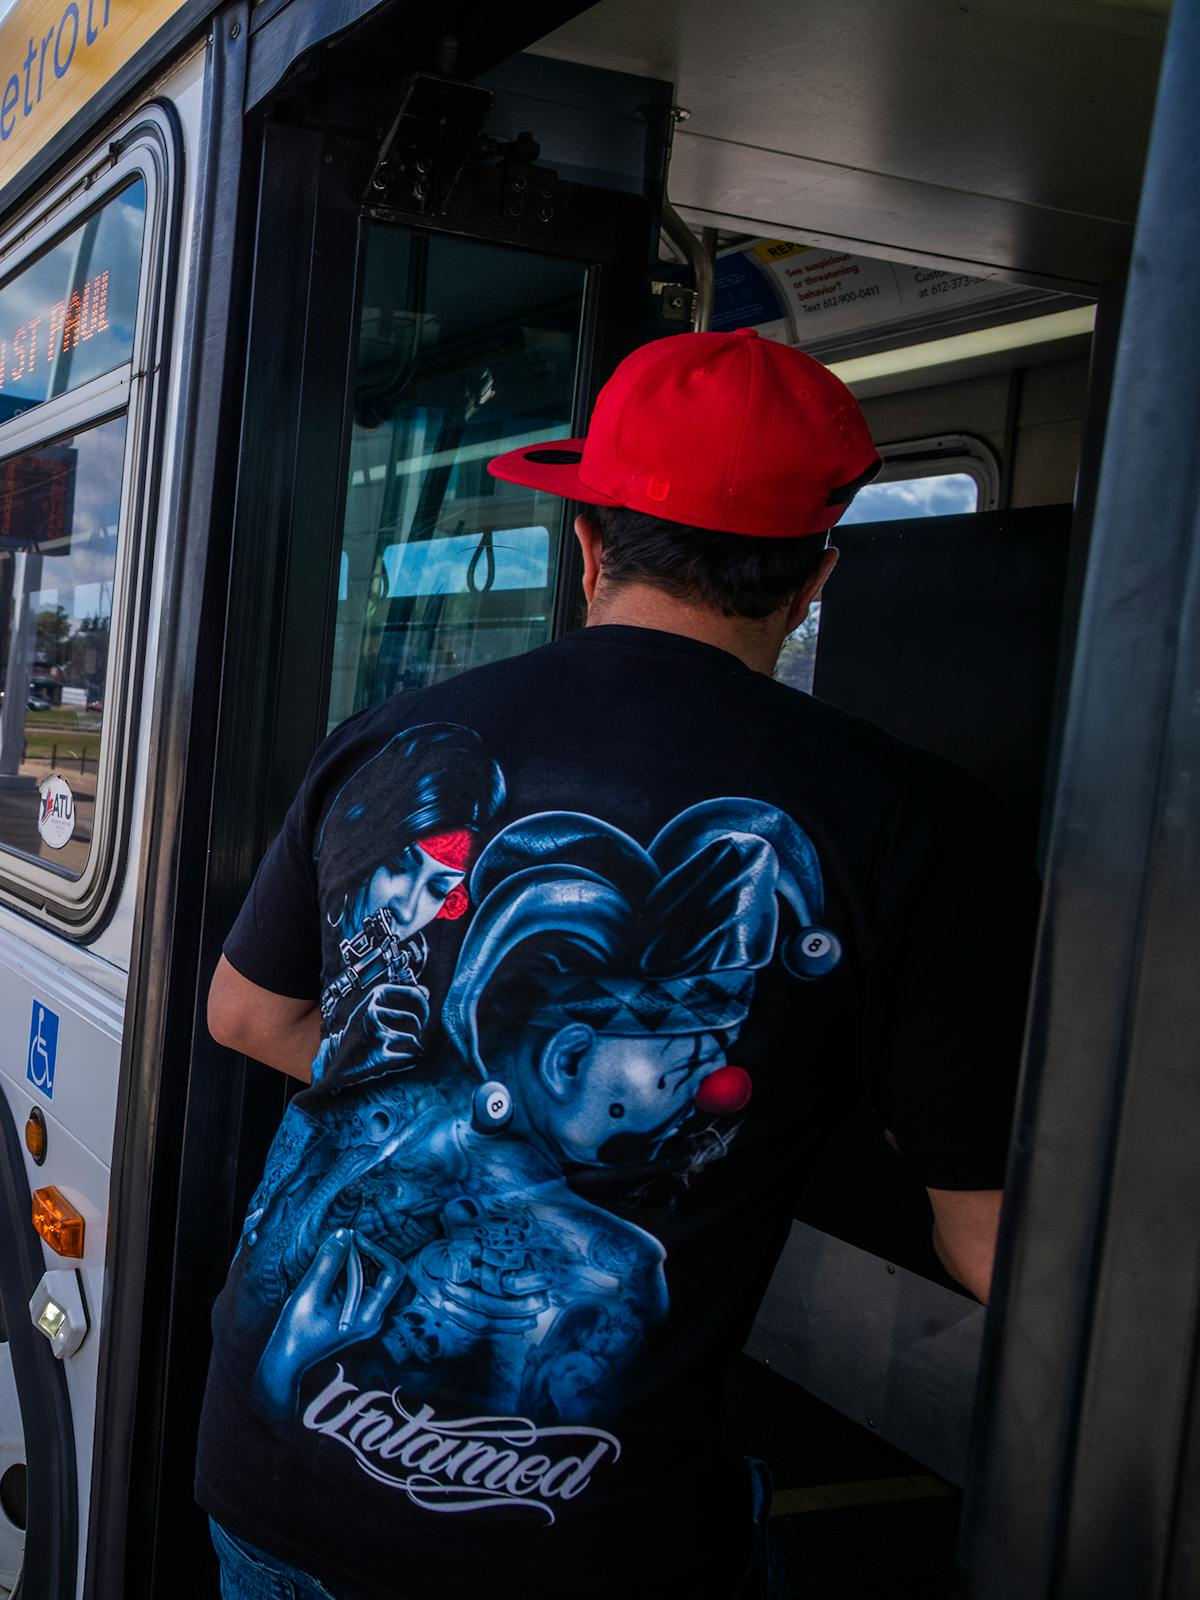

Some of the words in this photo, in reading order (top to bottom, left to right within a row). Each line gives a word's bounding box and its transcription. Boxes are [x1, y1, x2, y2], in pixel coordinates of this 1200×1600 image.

[767, 241, 809, 257] REP
[792, 281, 803, 290] or
[804, 265, 860, 286] threatening
[914, 270, 952, 284] Custo
[797, 281, 842, 301] behavior?
[918, 289, 929, 298] at
[802, 302, 822, 313] Text
[10, 312, 42, 382] ST
[47, 269, 110, 362] PAUL
[52, 793, 73, 820] ATU
[302, 1362, 616, 1506] Untamed
